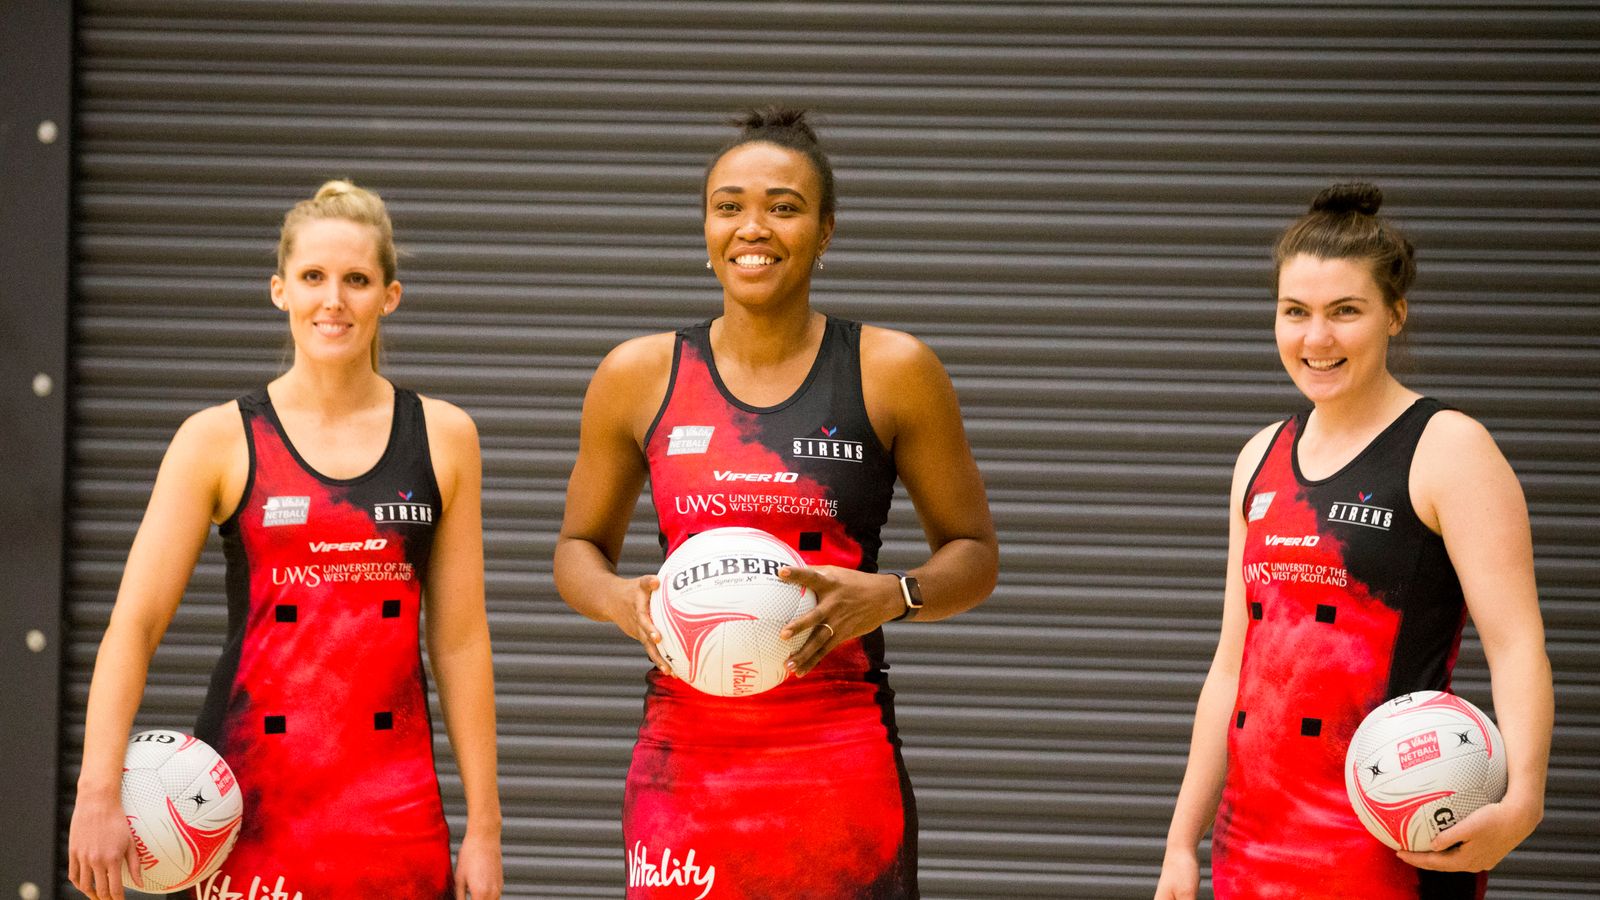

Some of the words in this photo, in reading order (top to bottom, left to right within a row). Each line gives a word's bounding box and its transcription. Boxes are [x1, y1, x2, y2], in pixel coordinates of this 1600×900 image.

[670, 439, 708, 448] NETBALL
[793, 440, 863, 460] SIRENS
[675, 493, 727, 516] UWS
[729, 493, 798, 505] UNIVERSITY
[800, 497, 815, 506] OF
[817, 498, 839, 509] THE
[265, 509, 306, 519] NETBALL
[374, 506, 432, 523] SIRENS
[729, 502, 760, 512] WEST
[761, 503, 773, 514] of
[776, 504, 838, 518] SCOTLAND
[1328, 504, 1393, 528] SIRENS
[272, 564, 321, 587] UWS
[323, 562, 382, 574] UNIVERSITY
[383, 562, 397, 572] OF
[398, 562, 413, 571] THE
[672, 557, 792, 591] GILBER
[1243, 561, 1271, 585] UWS
[1271, 562, 1314, 573] UNIVERSITY
[1315, 565, 1327, 576] OF
[1330, 566, 1347, 579] THE
[323, 572, 350, 582] WEST
[350, 571, 361, 583] of
[363, 571, 411, 581] SCOTLAND
[1271, 571, 1291, 581] WEST
[1291, 573, 1298, 583] of
[1300, 573, 1347, 587] SCOTLAND
[1400, 745, 1438, 763] NETBALL
[628, 840, 715, 900] Vitality
